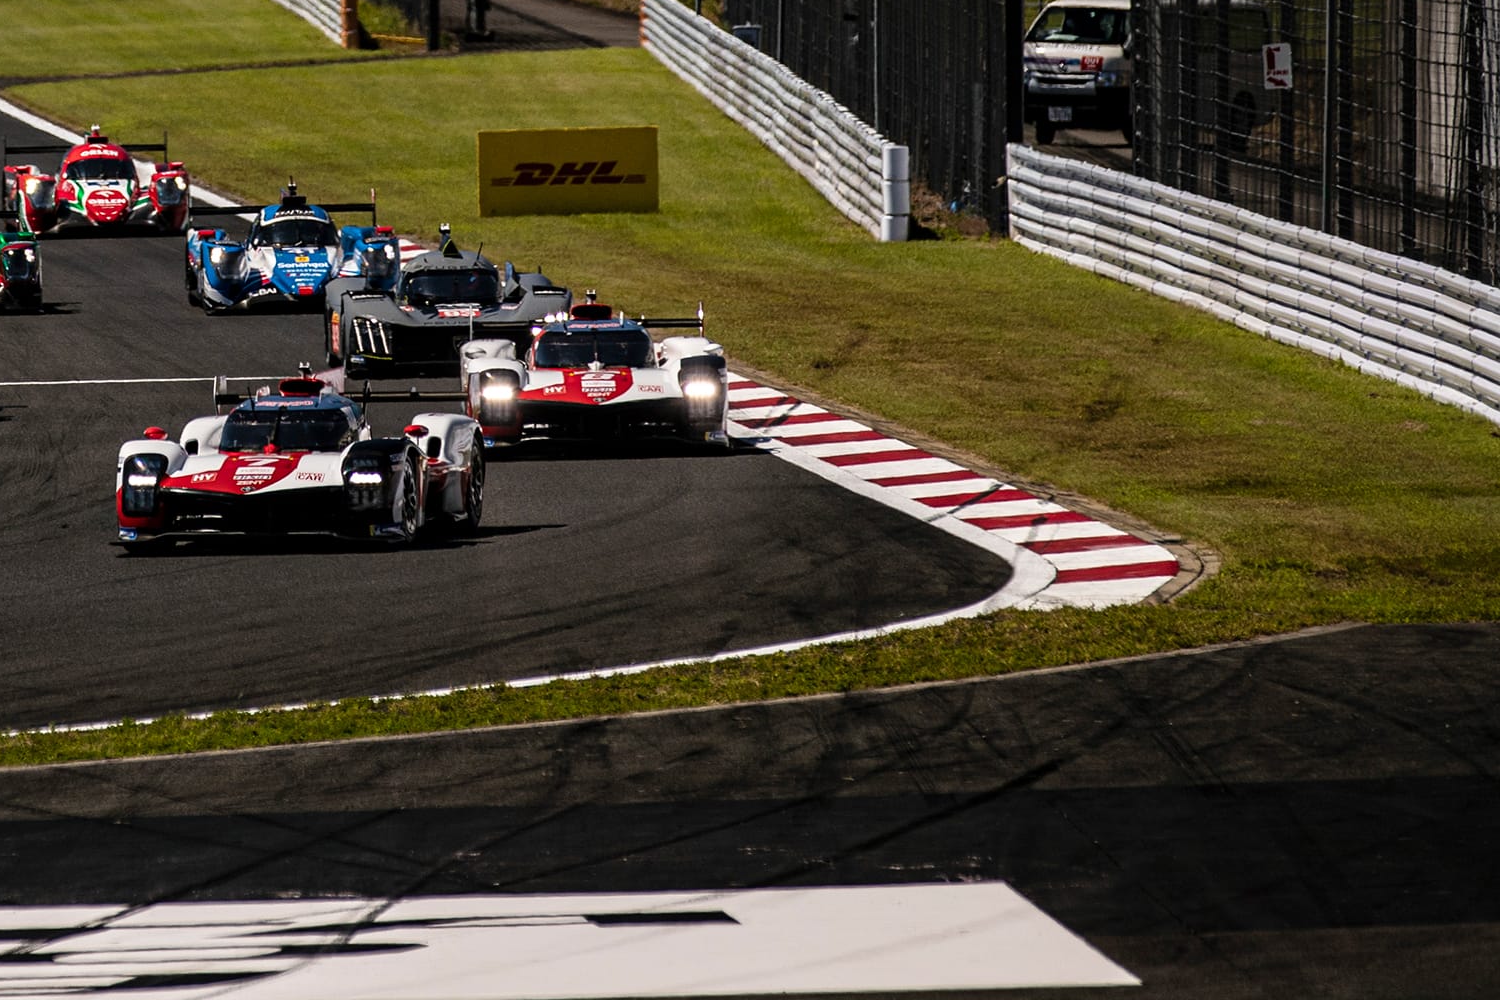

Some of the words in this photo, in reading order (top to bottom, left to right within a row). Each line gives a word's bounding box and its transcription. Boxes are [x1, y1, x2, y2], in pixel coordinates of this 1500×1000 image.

[80, 149, 119, 157] ORLEN
[513, 160, 623, 187] DHL
[277, 261, 330, 270] Sonangol
[243, 458, 280, 467] 7
[193, 473, 215, 482] HY
